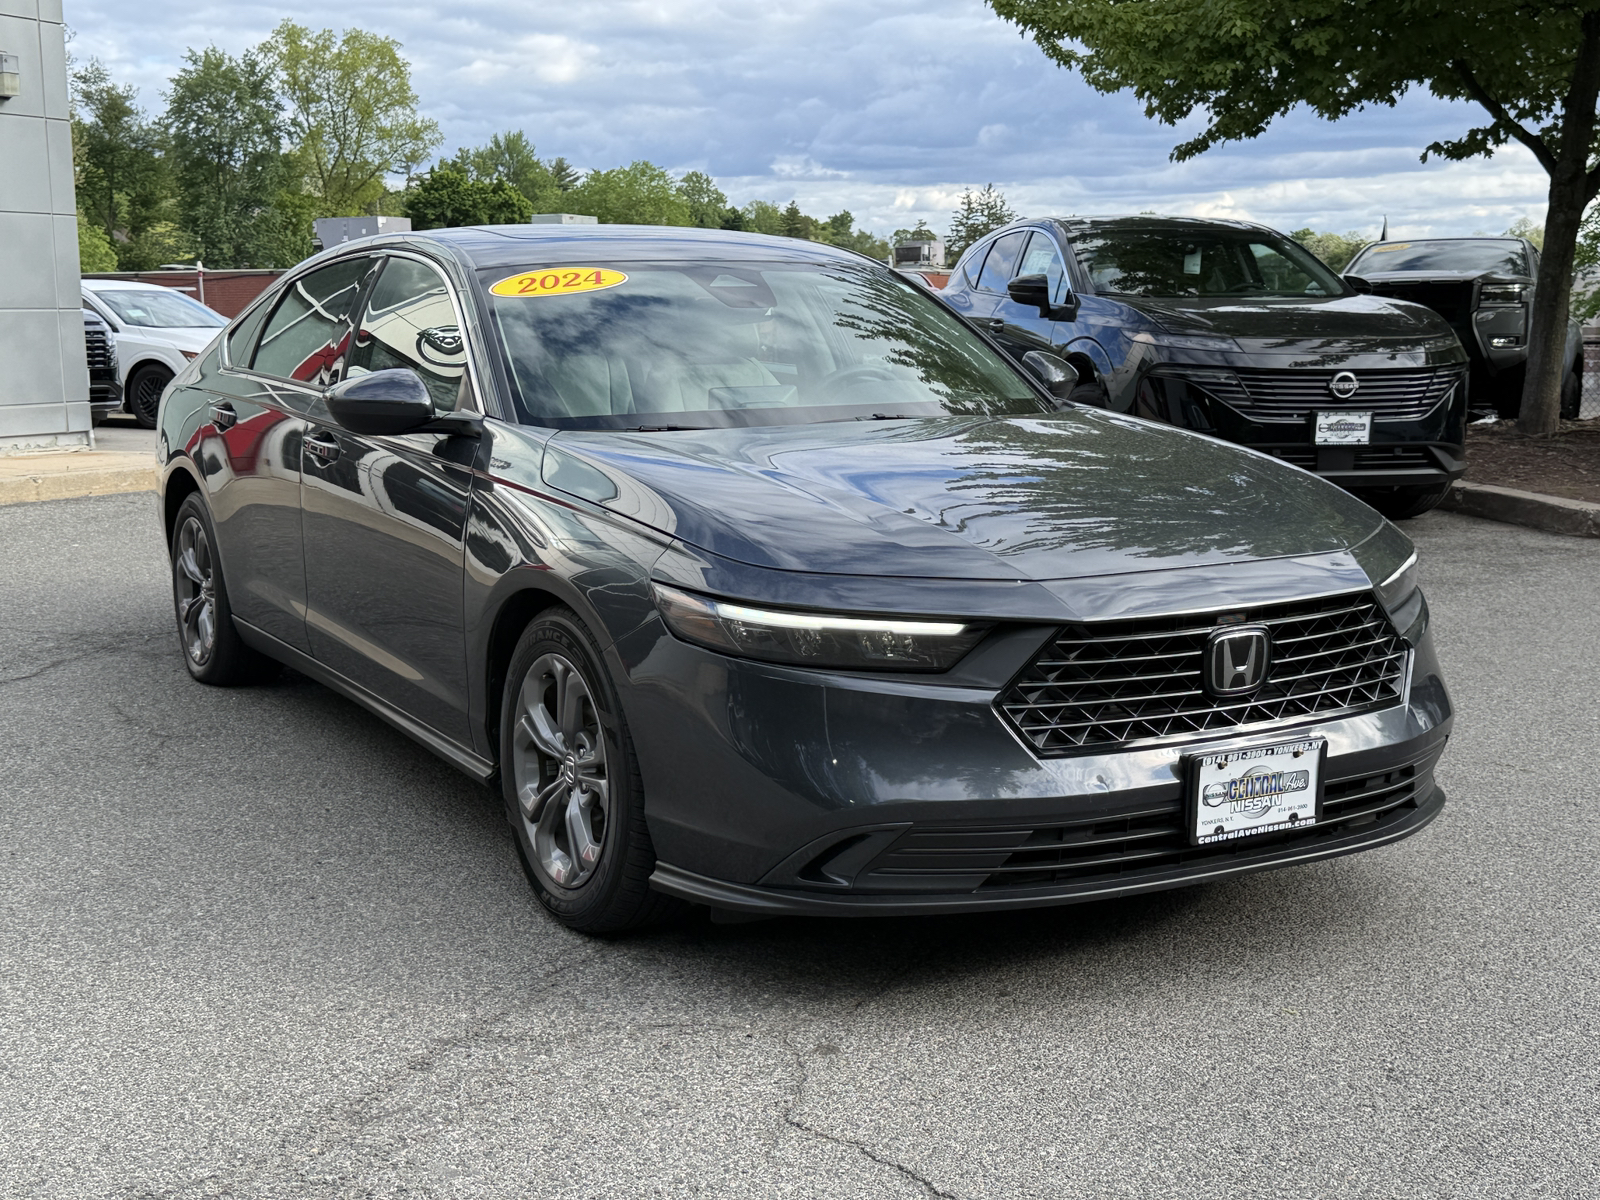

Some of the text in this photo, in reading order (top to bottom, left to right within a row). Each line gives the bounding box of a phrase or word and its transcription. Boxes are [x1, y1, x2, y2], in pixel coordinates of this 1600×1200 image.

[518, 271, 606, 294] 2024
[1228, 771, 1306, 801] CENTRAL Ave.
[1230, 794, 1283, 814] NISSAN
[1198, 818, 1316, 844] CentralAveNissan.com
